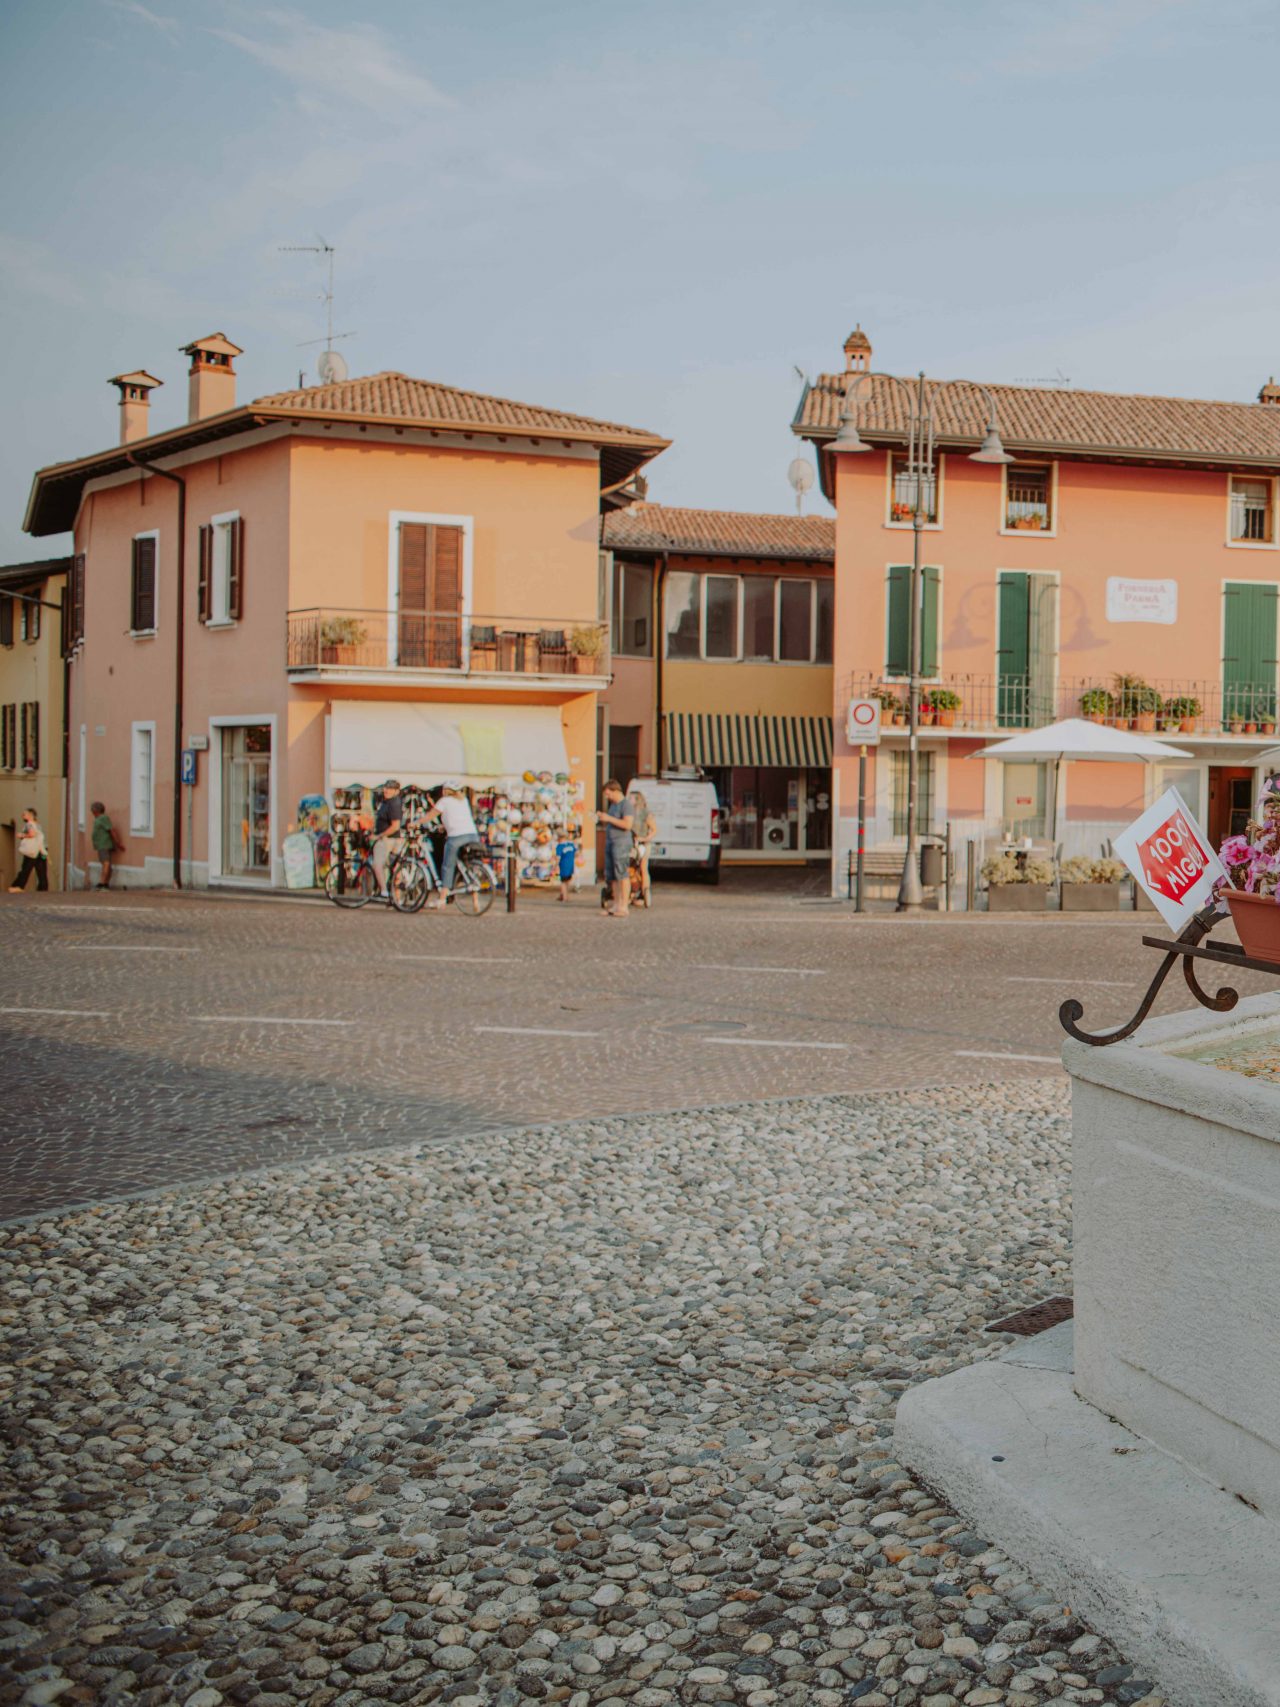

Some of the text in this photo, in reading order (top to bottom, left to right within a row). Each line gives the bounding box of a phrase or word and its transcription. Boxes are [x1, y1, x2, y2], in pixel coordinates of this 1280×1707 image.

[183, 752, 193, 781] P
[1150, 818, 1189, 864] 1000
[1166, 844, 1204, 894] MIGL
